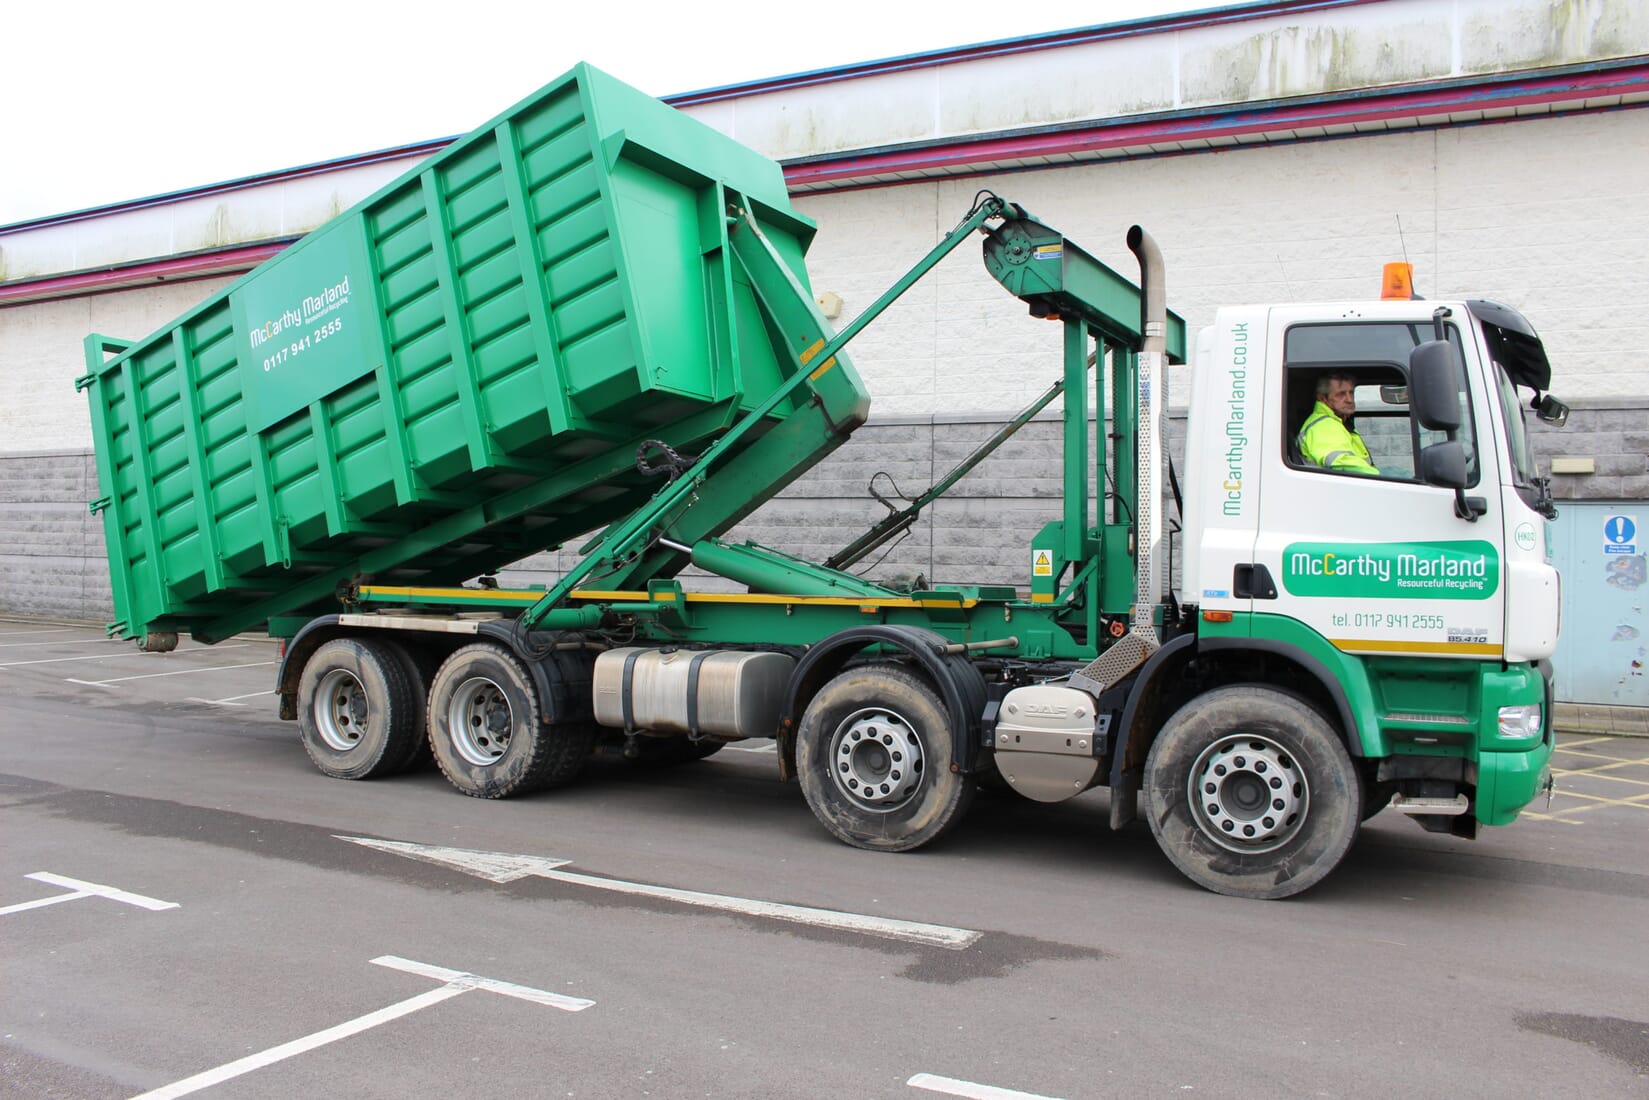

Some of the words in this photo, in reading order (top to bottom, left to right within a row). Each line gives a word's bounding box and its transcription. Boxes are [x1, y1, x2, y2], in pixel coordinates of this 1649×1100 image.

[250, 308, 302, 349] McCarthy
[302, 274, 350, 317] Marland
[263, 348, 288, 372] 0117
[291, 335, 311, 356] 941
[313, 317, 342, 344] 2555
[1223, 322, 1248, 516] McCarthyMarland.co.uk
[1291, 553, 1390, 582] McCarthy
[1397, 554, 1485, 577] Marland
[1397, 578, 1444, 588] Resourceful
[1445, 579, 1484, 590] Recycling
[1332, 612, 1351, 627] tel.
[1354, 613, 1383, 628] 0117
[1386, 614, 1409, 629] 941
[1412, 614, 1444, 630] 2555
[1447, 627, 1488, 636] DAF
